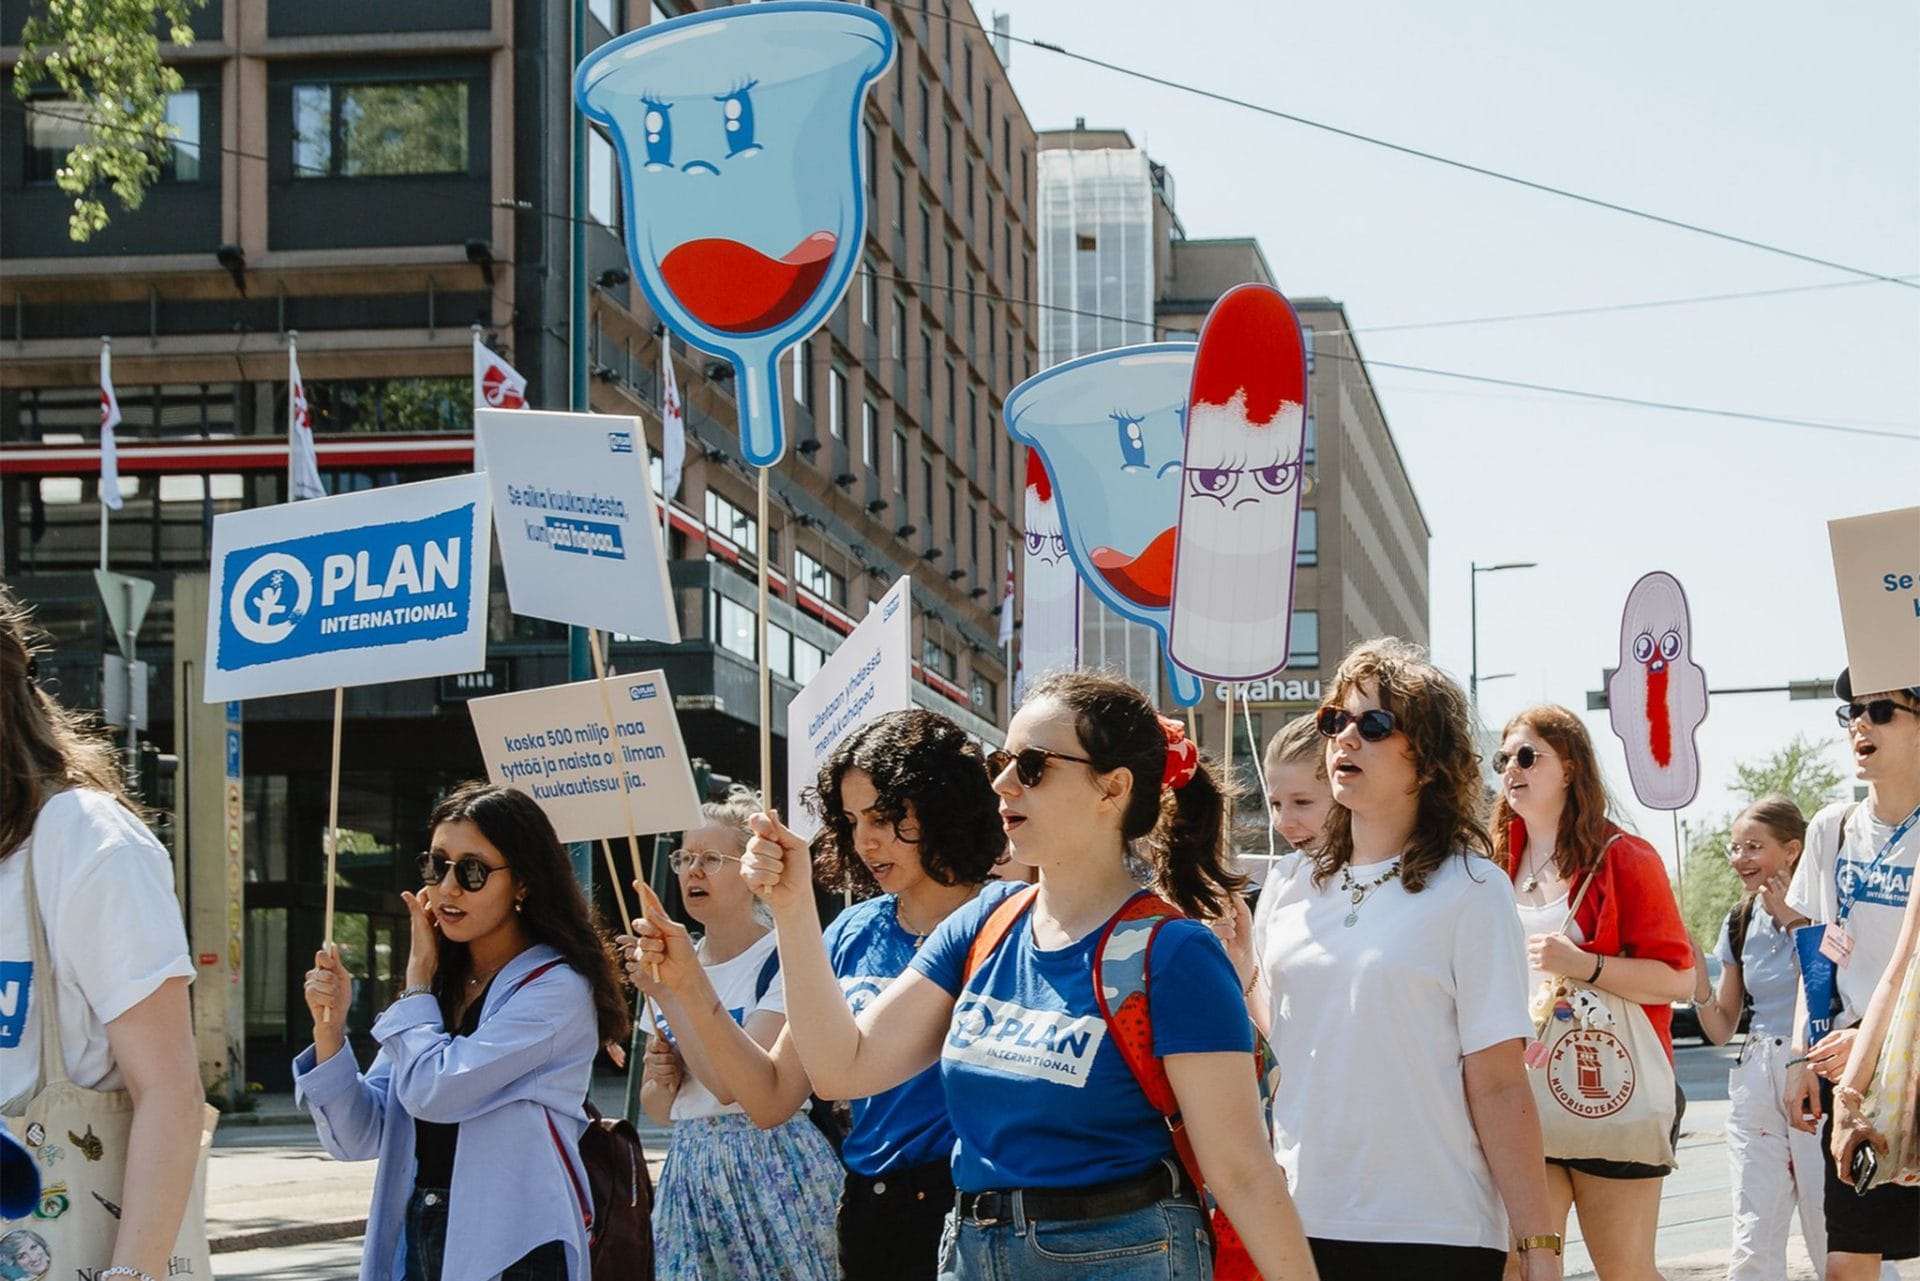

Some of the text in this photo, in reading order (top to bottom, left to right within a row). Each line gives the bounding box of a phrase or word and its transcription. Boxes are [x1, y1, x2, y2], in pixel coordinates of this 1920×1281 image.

[321, 536, 461, 606] PLAN
[1883, 573, 1913, 592] Se
[320, 601, 458, 635] INTERNATIONAL
[504, 721, 645, 752] koska 500 miljonaa
[501, 758, 541, 783] tyttöä
[542, 756, 556, 778] ja
[558, 751, 601, 771] naista
[622, 745, 666, 763] ilman
[995, 1017, 1092, 1059] PLAN
[1554, 1033, 1625, 1061] MASALAN
[987, 1047, 1078, 1075] INTERNATIONAL
[1551, 1077, 1631, 1114] NUORISOTEATTERI
